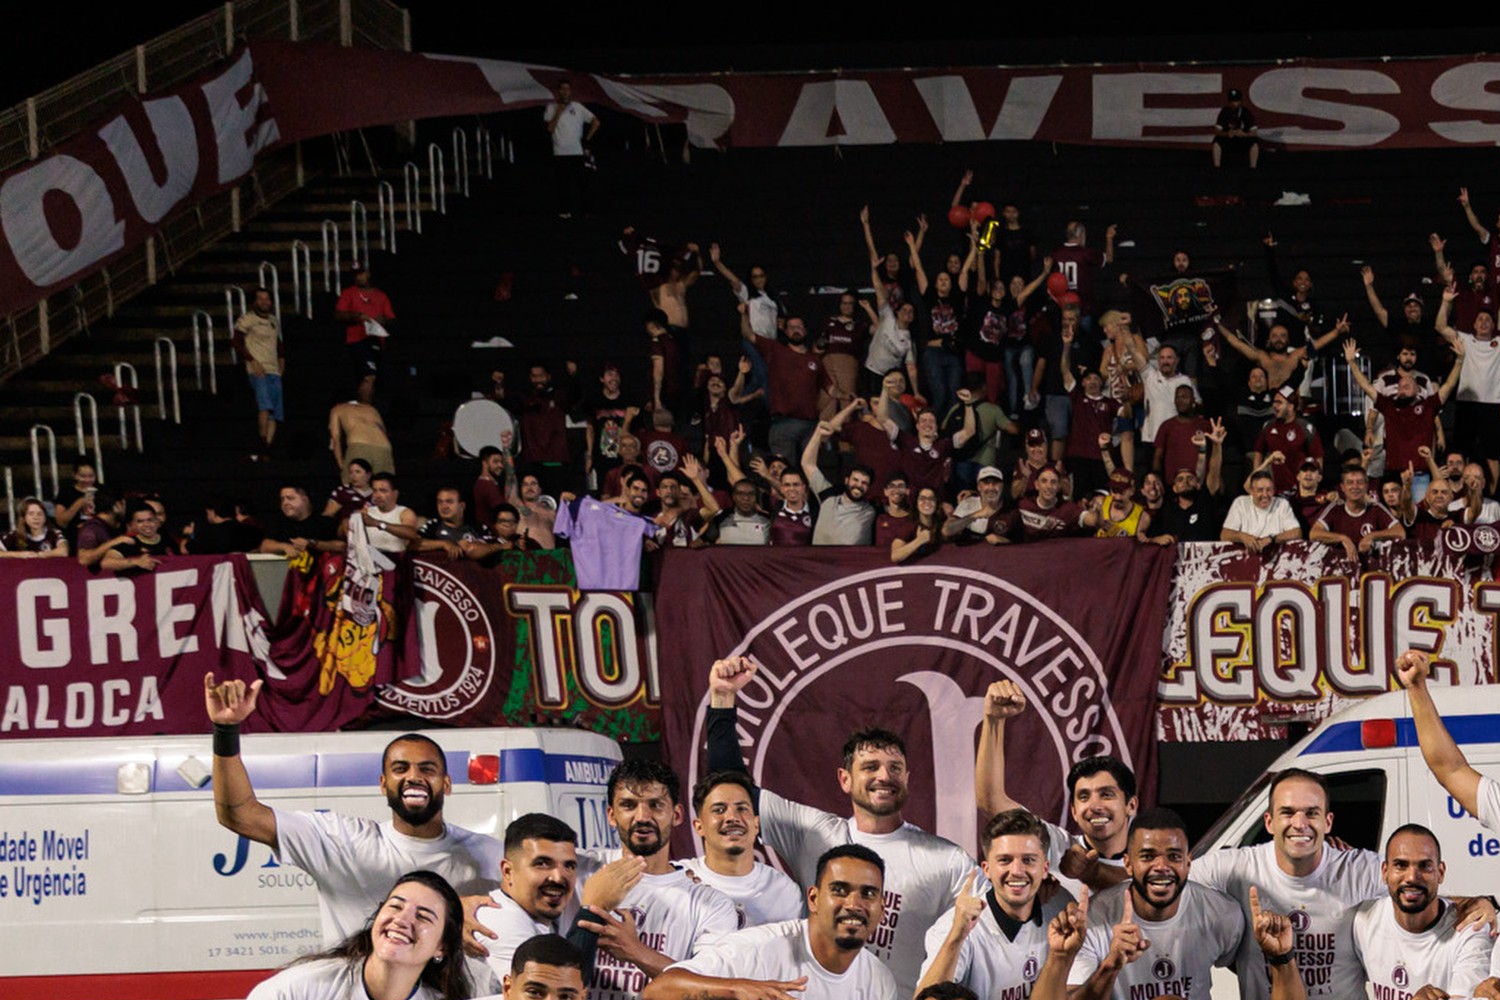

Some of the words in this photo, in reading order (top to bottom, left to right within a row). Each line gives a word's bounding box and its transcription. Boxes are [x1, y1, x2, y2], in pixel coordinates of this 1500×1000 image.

[414, 566, 480, 622] RAVESSO
[42, 828, 90, 861] Móvel
[14, 864, 87, 905] Urgência
